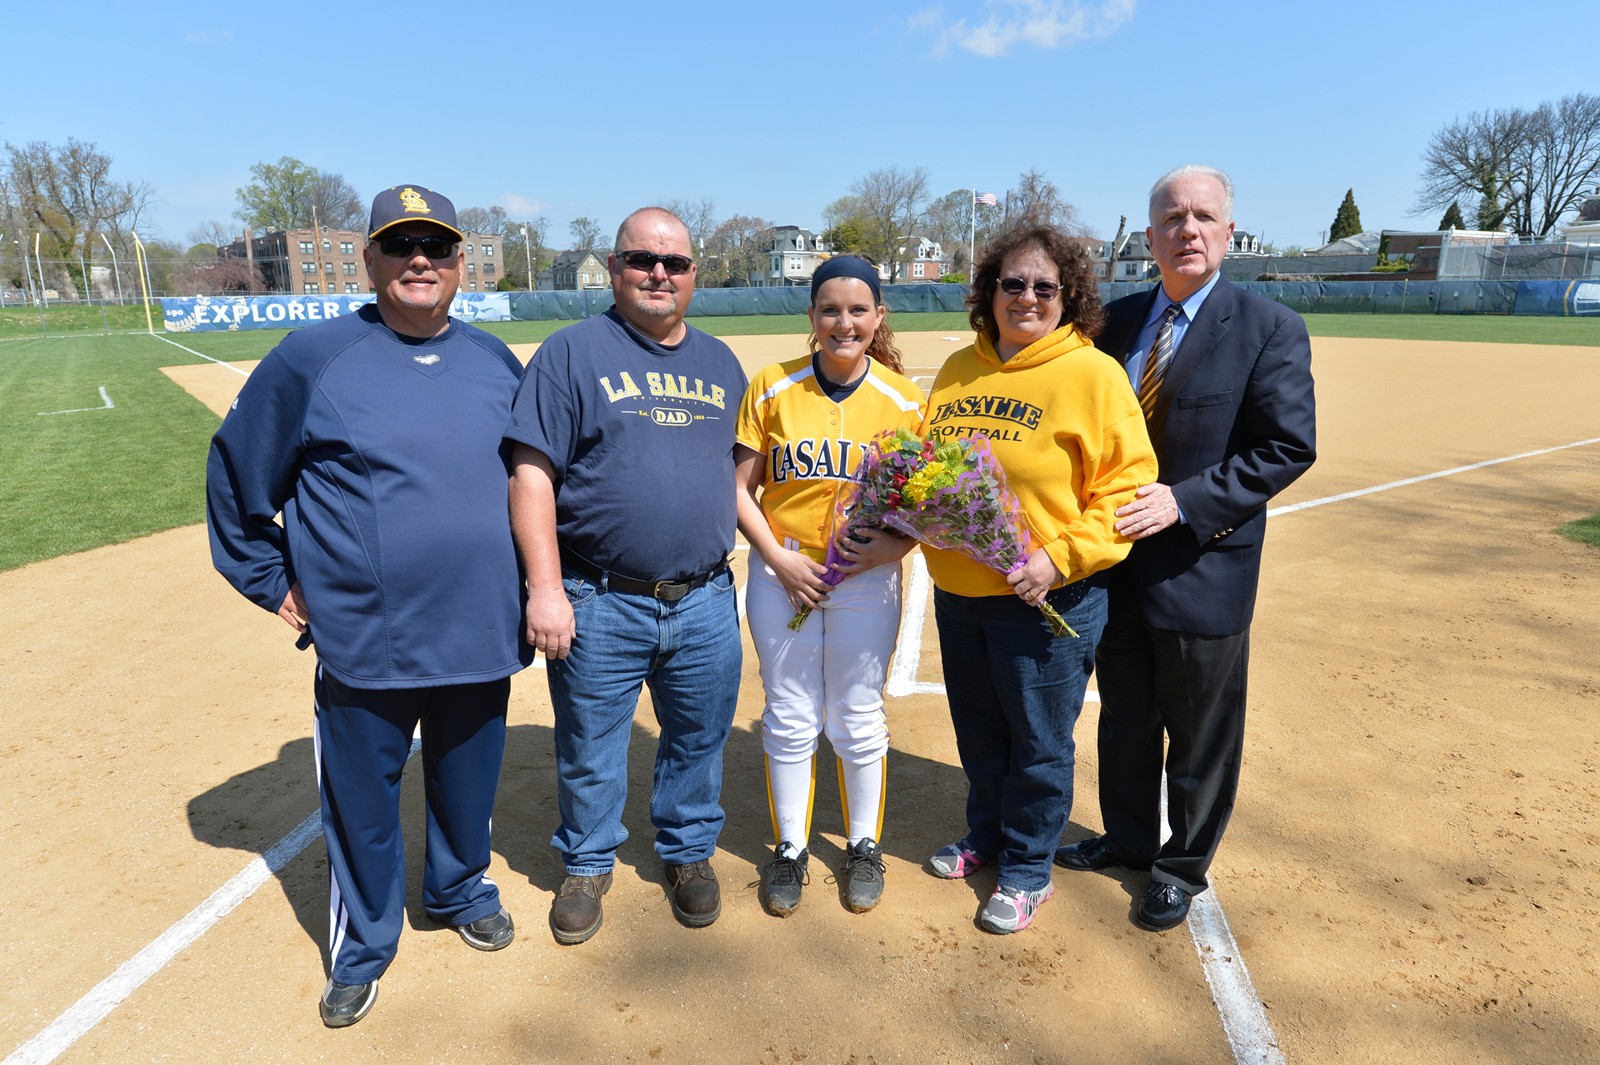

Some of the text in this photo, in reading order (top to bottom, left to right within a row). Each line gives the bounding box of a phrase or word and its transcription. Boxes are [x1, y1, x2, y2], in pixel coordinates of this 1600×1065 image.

[165, 309, 184, 317] 190
[193, 301, 340, 324] EXPLORER
[600, 371, 726, 410] LA SALLE
[655, 409, 687, 424] DAD
[929, 395, 1044, 431] LASALLE
[932, 425, 1022, 442] SOFTBALL
[770, 437, 872, 484] LASAL
